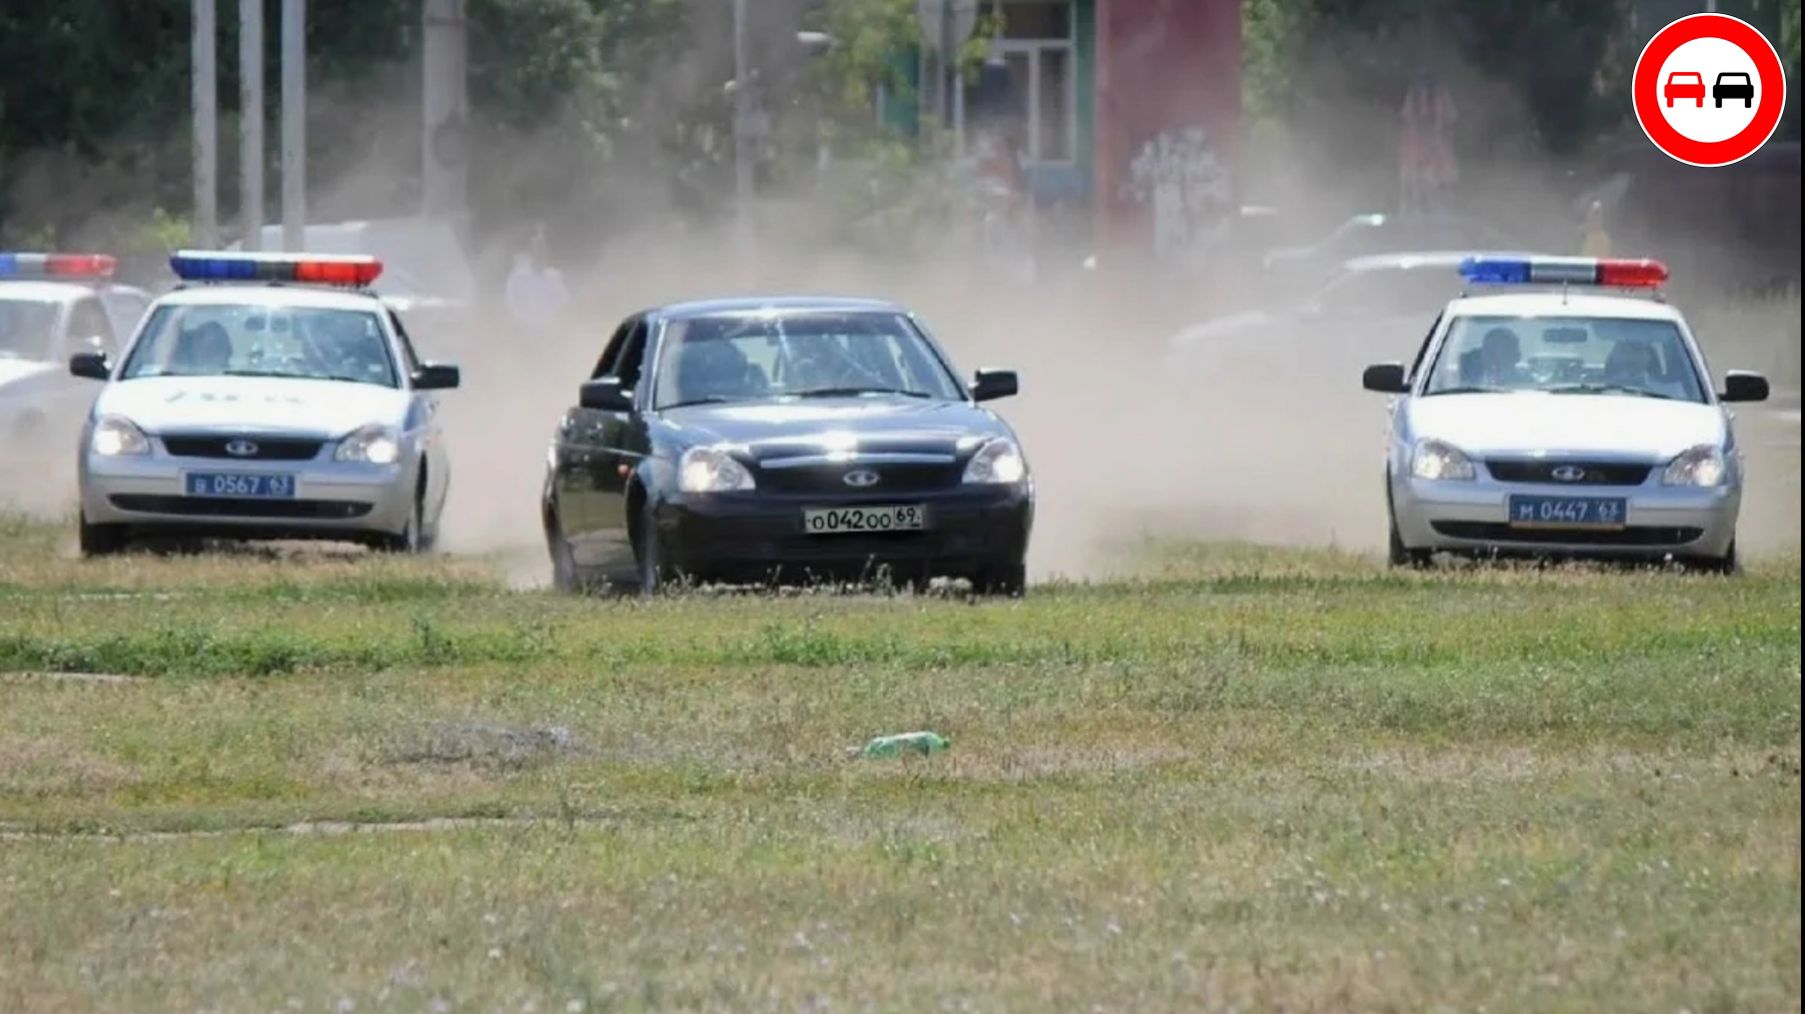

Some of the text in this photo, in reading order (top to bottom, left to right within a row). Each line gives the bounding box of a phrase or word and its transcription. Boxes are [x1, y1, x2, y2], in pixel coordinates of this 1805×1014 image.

[214, 475, 259, 494] 0567
[896, 507, 916, 522] 69
[1541, 501, 1588, 520] 0447
